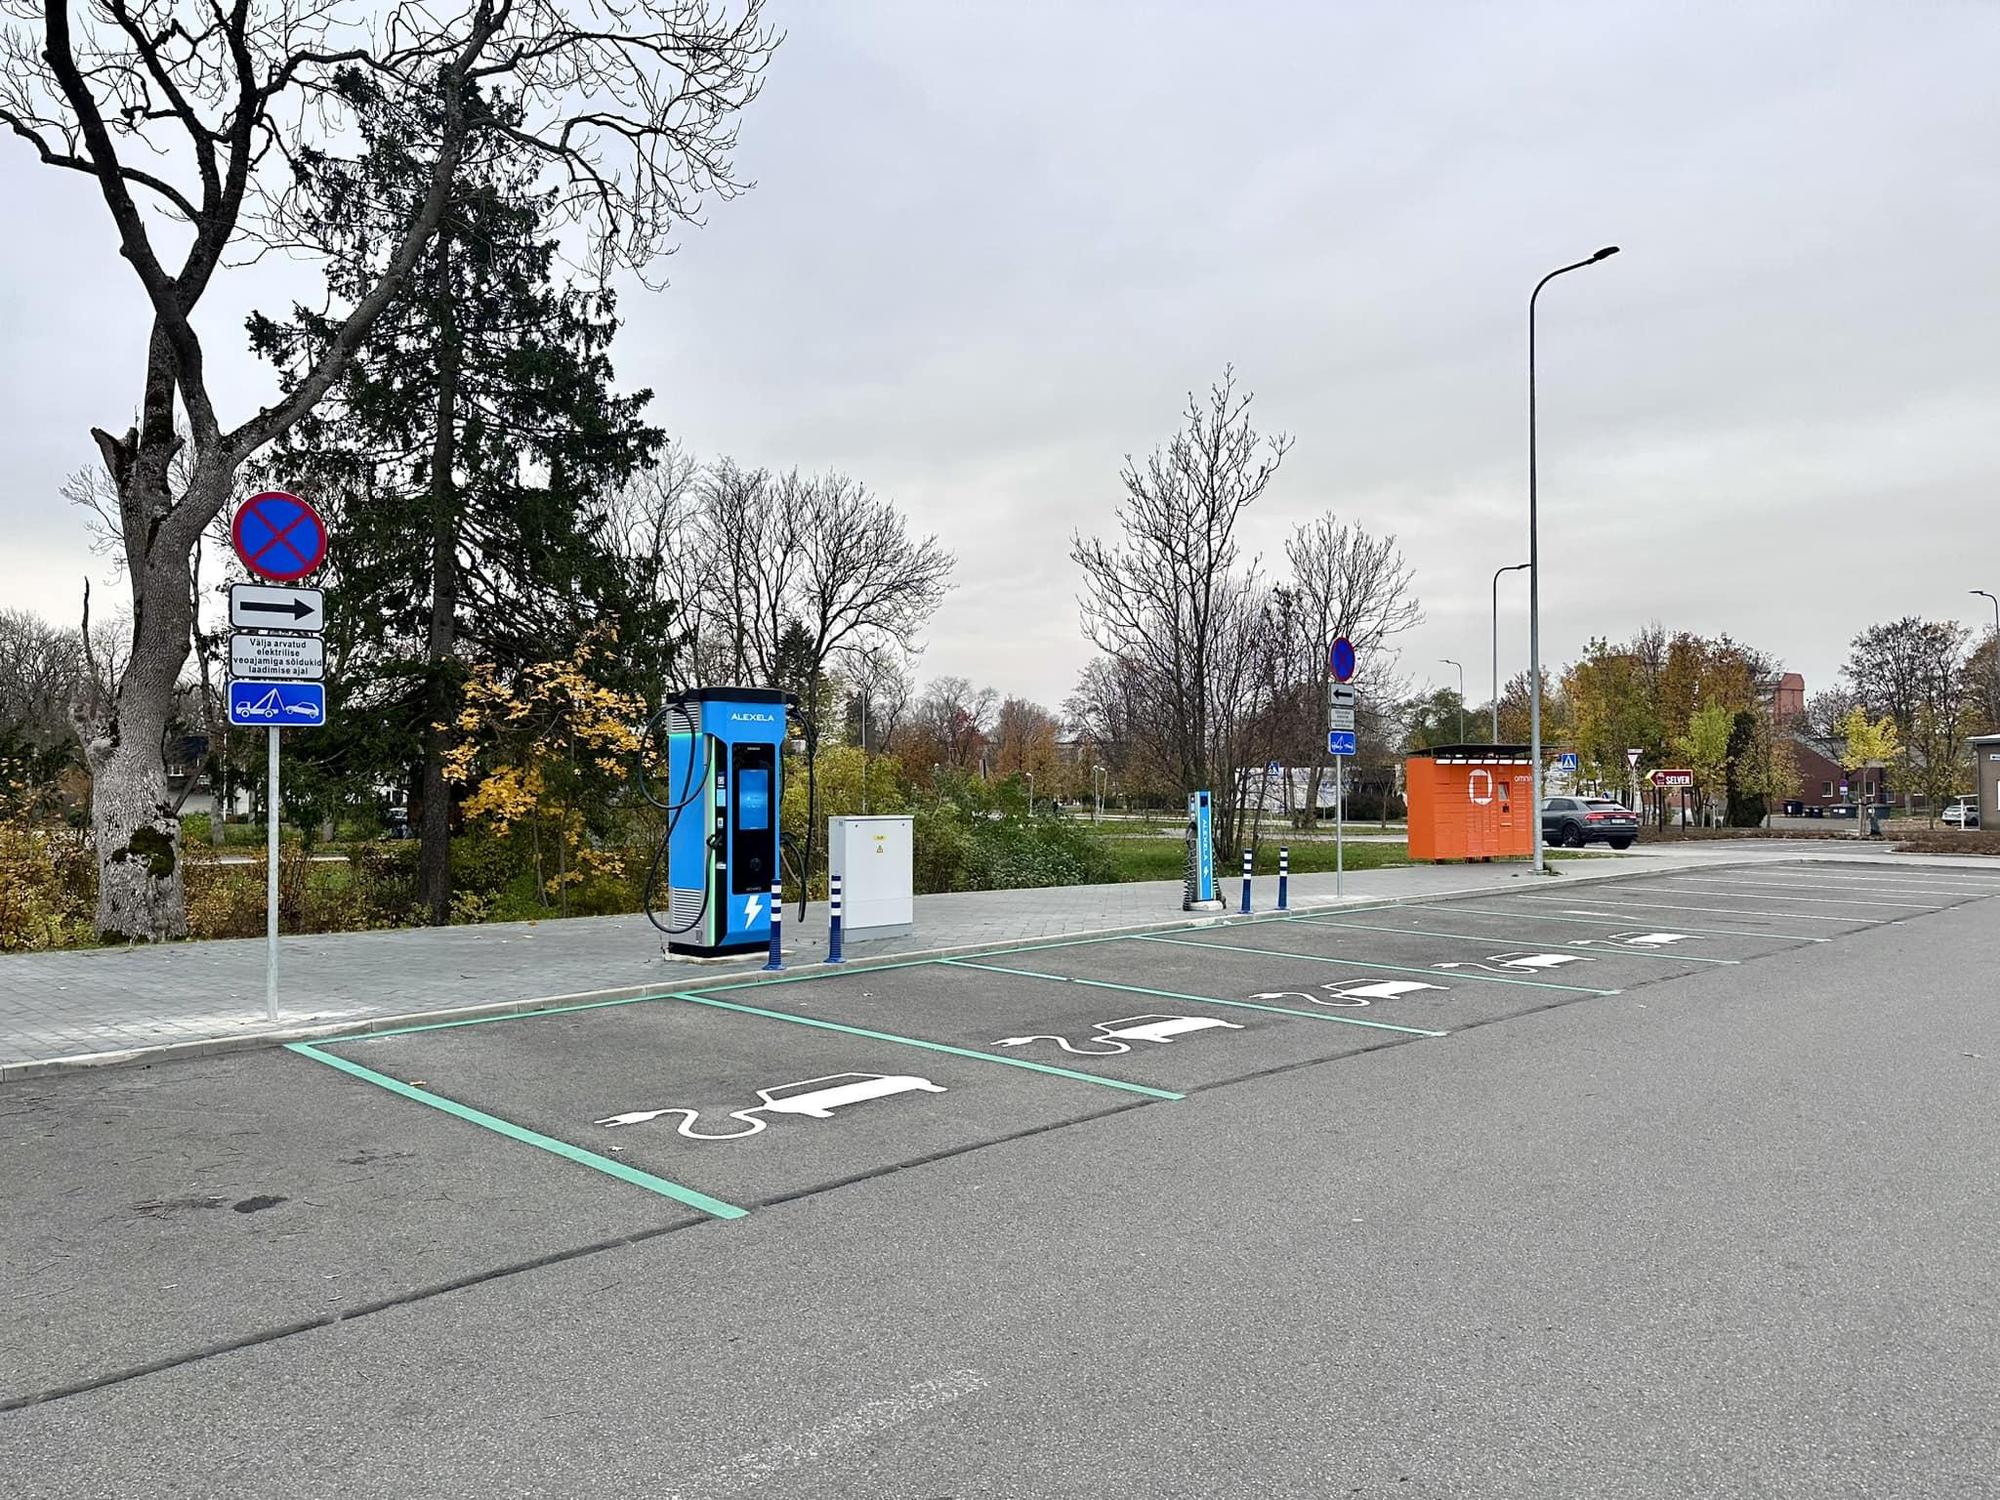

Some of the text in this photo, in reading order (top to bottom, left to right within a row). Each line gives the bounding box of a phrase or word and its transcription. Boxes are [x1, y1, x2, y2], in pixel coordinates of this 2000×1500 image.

[249, 638, 307, 649] Välja arvatud
[256, 648, 300, 657] elektrilise
[233, 657, 284, 666] veoajamiga
[248, 665, 308, 676] laadimise ajal
[731, 712, 775, 722] ALEXELA
[1665, 775, 1690, 785] SELVER
